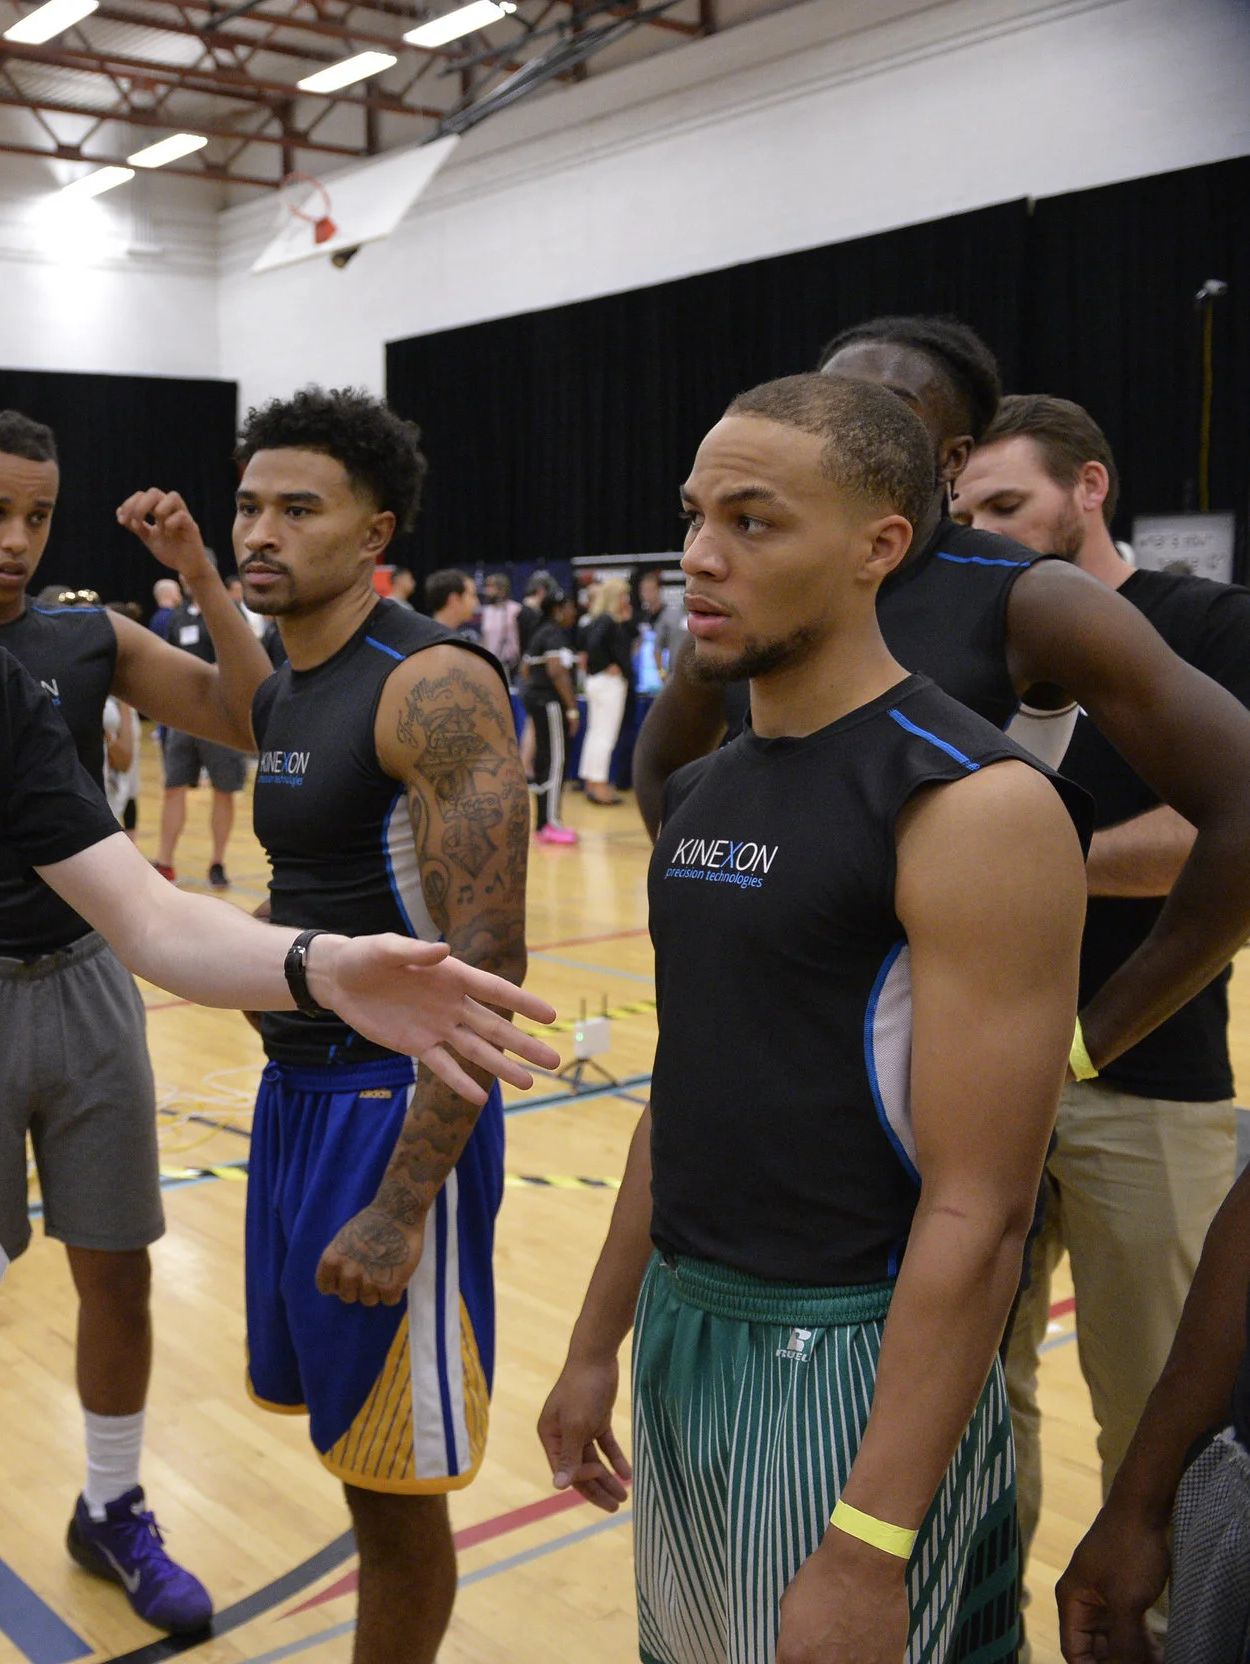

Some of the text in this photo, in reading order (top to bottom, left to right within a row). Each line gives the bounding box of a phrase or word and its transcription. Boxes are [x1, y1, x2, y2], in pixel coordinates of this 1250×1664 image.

[671, 838, 779, 873] KINEXON
[664, 866, 763, 888] precision technologies
